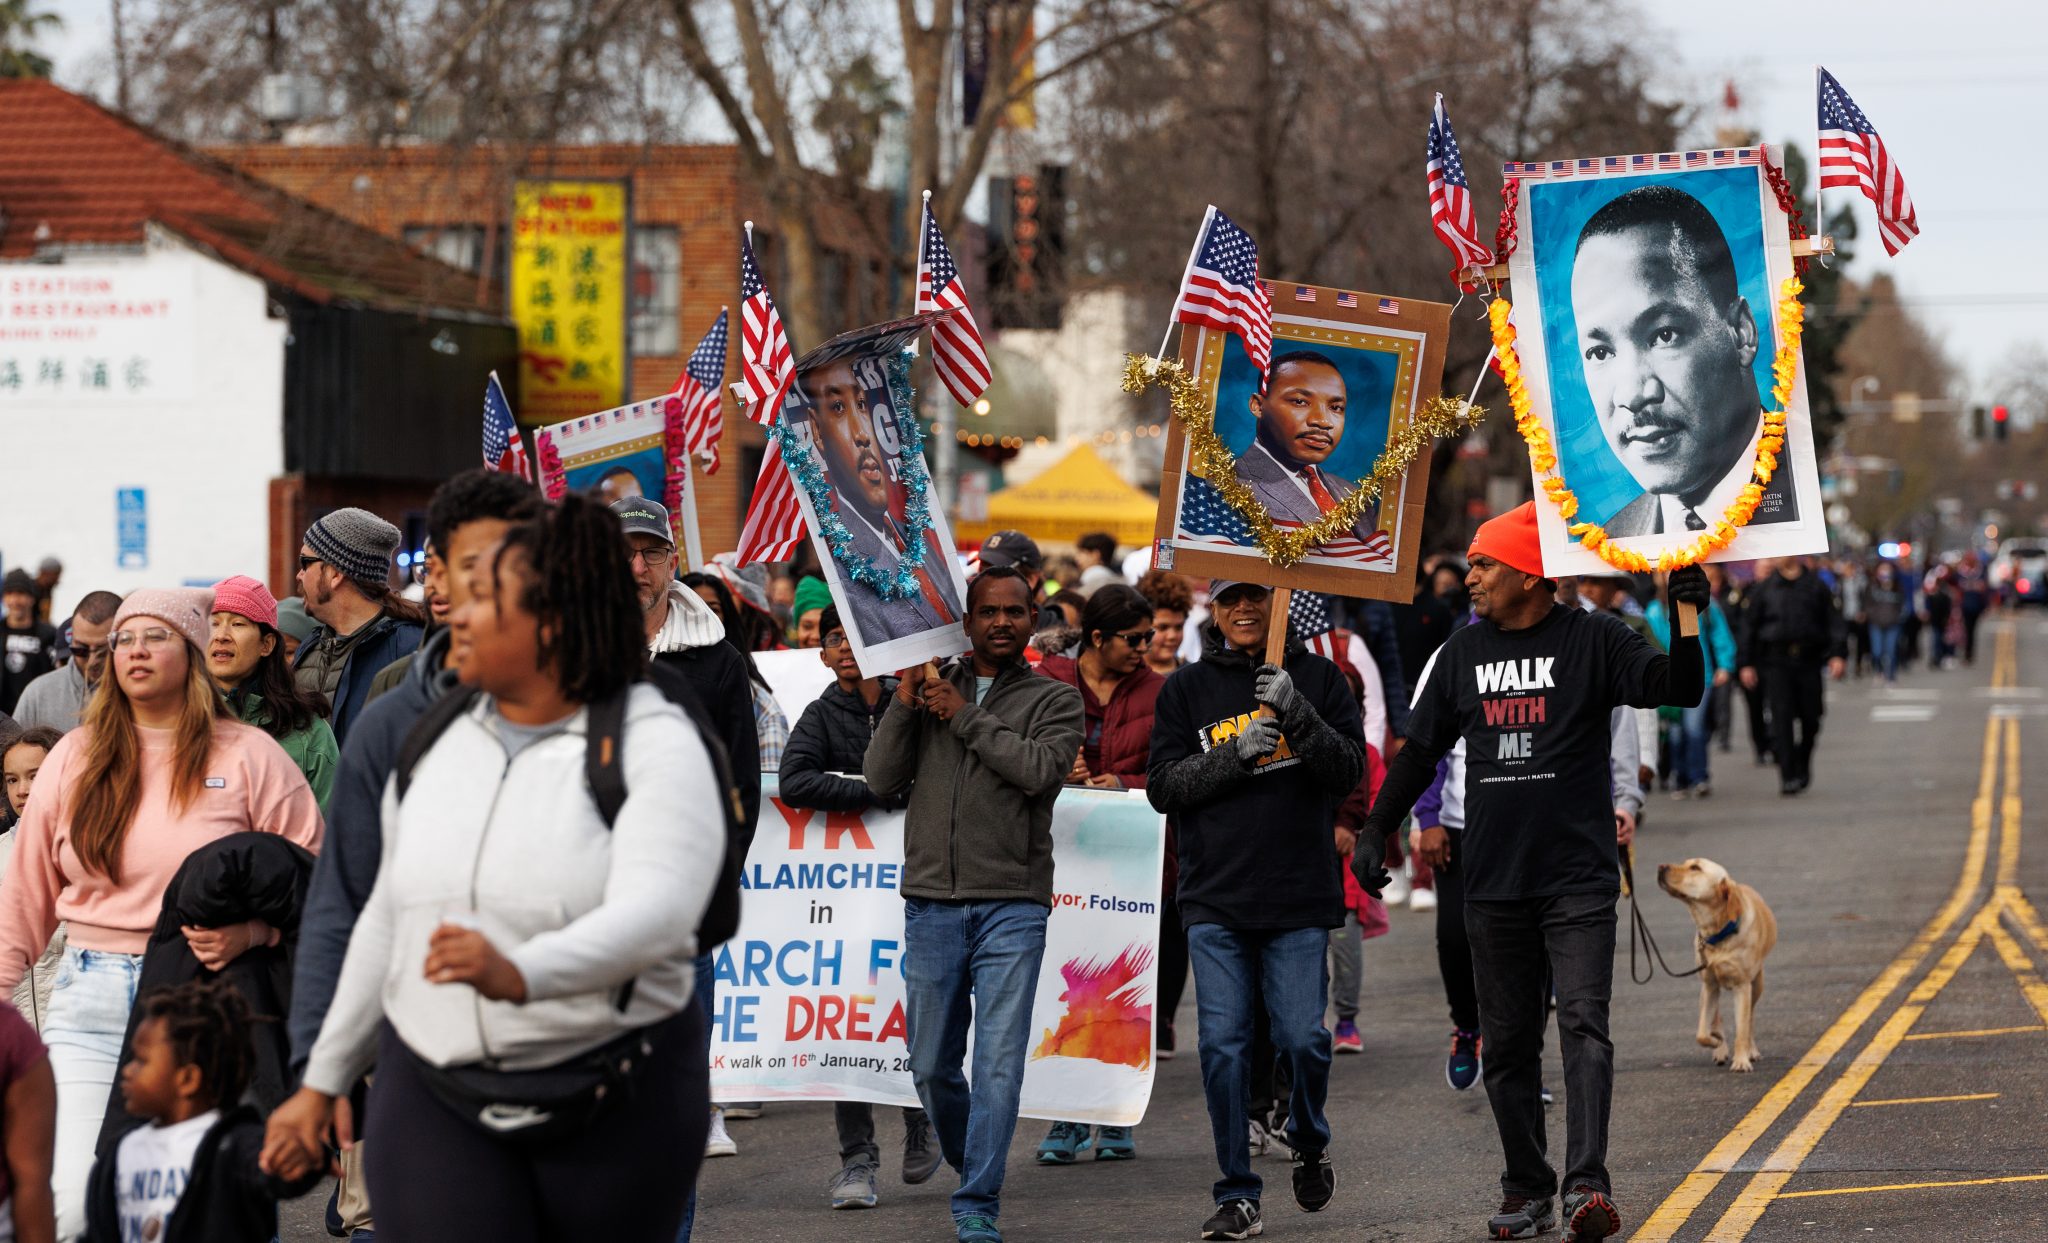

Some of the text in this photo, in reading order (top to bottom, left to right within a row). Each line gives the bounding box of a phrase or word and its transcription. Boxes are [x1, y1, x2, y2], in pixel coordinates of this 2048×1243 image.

[541, 195, 594, 210] NEW
[519, 218, 619, 234] STATION
[10, 278, 112, 293] STATION
[11, 302, 169, 318] RESTAURANT
[1475, 657, 1555, 694] WALK
[1482, 697, 1546, 727] WITH
[1497, 732, 1533, 760] ME
[1532, 772, 1555, 780] MATTER
[738, 863, 905, 890] ALAMCHE
[809, 899, 834, 924] in
[1090, 894, 1155, 915] Folsom
[714, 939, 906, 987] ARCH F
[730, 1055, 762, 1069] walk
[768, 1057, 786, 1068] on
[791, 1053, 816, 1068] 16th
[819, 1052, 888, 1073] January,
